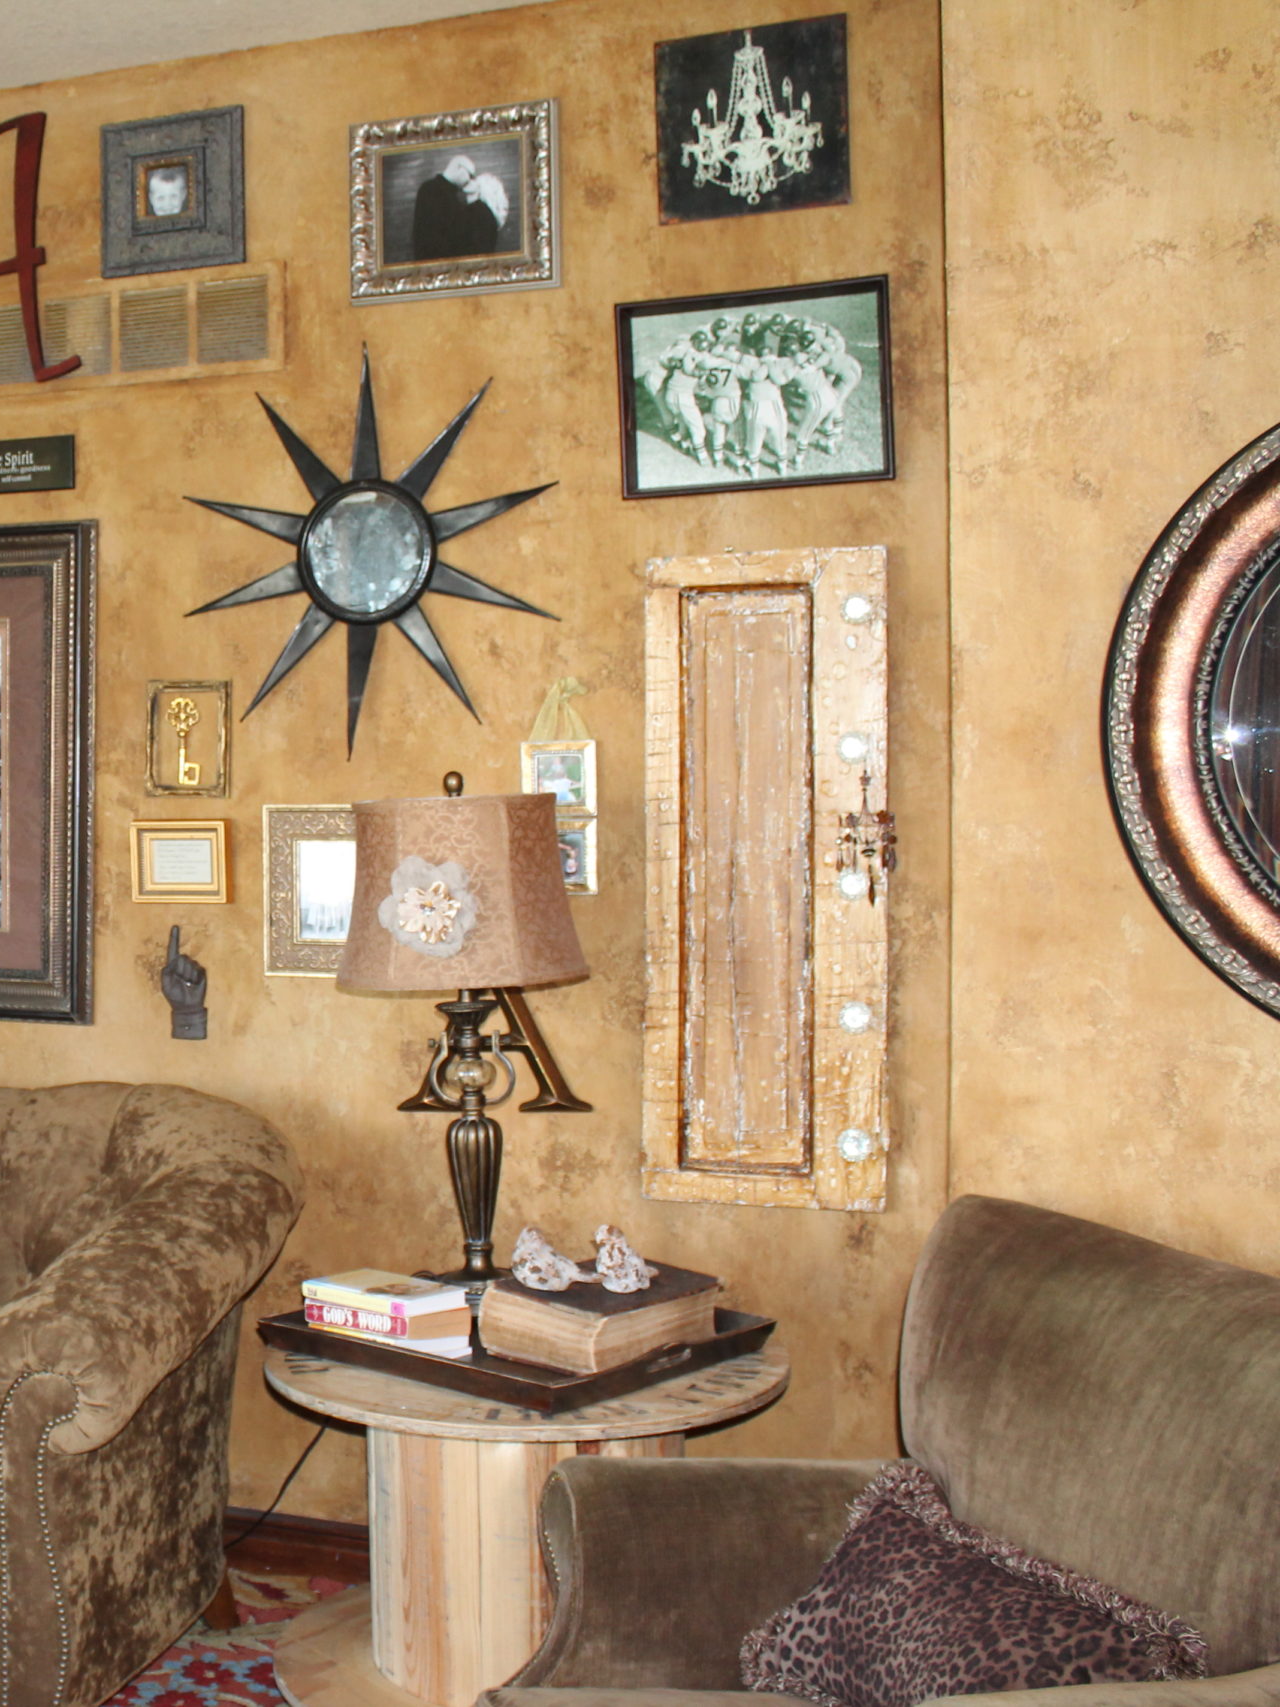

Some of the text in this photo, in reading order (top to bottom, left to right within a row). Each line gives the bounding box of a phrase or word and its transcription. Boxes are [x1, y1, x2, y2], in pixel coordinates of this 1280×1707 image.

[4, 450, 34, 470] Spirit
[322, 1305, 354, 1327] GOD'S
[357, 1310, 392, 1333] WORD
